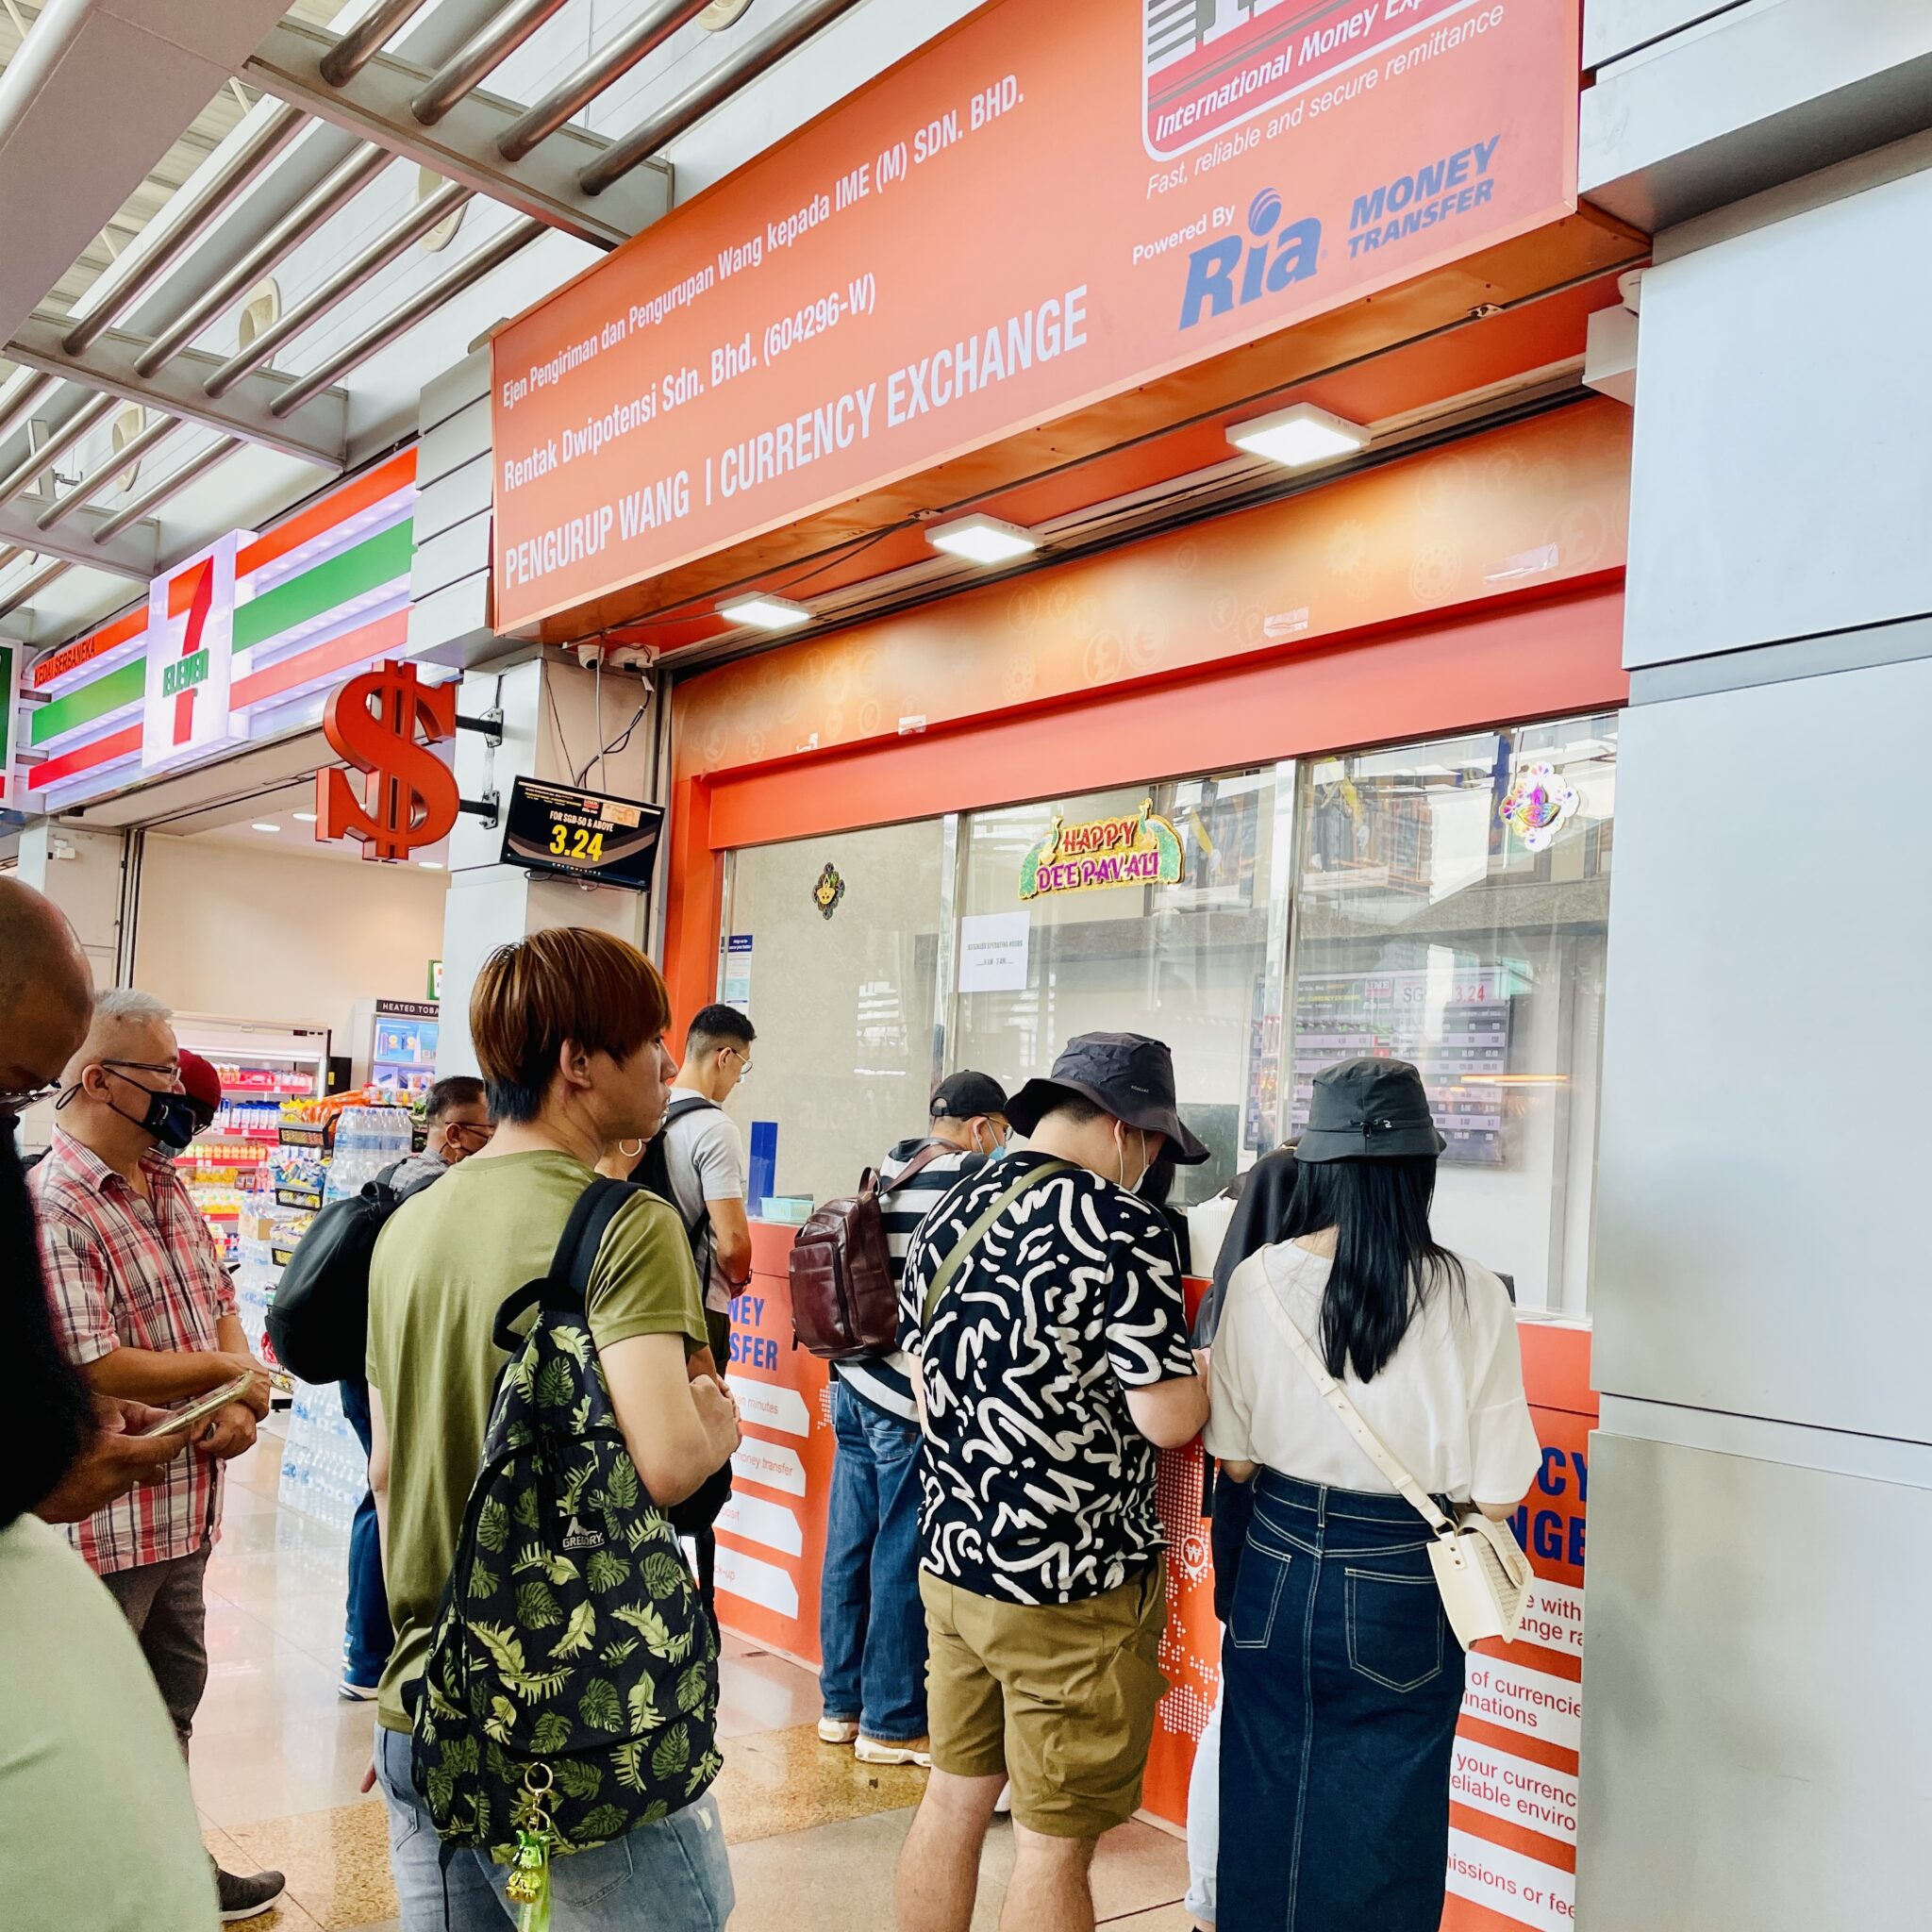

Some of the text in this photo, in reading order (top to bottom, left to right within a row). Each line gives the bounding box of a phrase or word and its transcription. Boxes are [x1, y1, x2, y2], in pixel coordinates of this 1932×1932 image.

[1156, 45, 1292, 142] International
[1297, 3, 1378, 67] Money
[1146, 4, 1504, 200] Fast, reliable and secure remittance
[1349, 133, 1502, 231] MONEY
[1132, 204, 1236, 265] Powered By
[1347, 177, 1494, 259] TRANSFER
[503, 74, 1024, 409] Ejen Pengiriman dan Pengurupan Wang kepada IME (M) SDN. BHD.
[1178, 187, 1322, 331] Ria
[504, 272, 875, 492] Rentak Dwipotensi Sdn. Bhd. (604296-W)
[506, 505, 613, 590] PENGURUP
[618, 469, 689, 541] WANG
[720, 381, 876, 499] CURRENCY
[887, 284, 1088, 429] EXCHANGE
[549, 810, 563, 822] FOR
[592, 819, 614, 832] ABOVE
[1062, 820, 1137, 854] HAPPY
[549, 824, 604, 862] 3.24
[382, 1002, 415, 1012] HEATED
[1403, 984, 1485, 1003] SG 3.24
[730, 1332, 777, 1371] SFER
[748, 1397, 778, 1415] minutes
[735, 1452, 793, 1476] money transfer
[1541, 1598, 1581, 1622] with
[1464, 1688, 1538, 1728] inations
[1472, 1672, 1581, 1719] of currencie
[1457, 1753, 1576, 1807] your currenc
[1517, 1799, 1576, 1831] enviro
[1524, 1885, 1543, 1906] or
